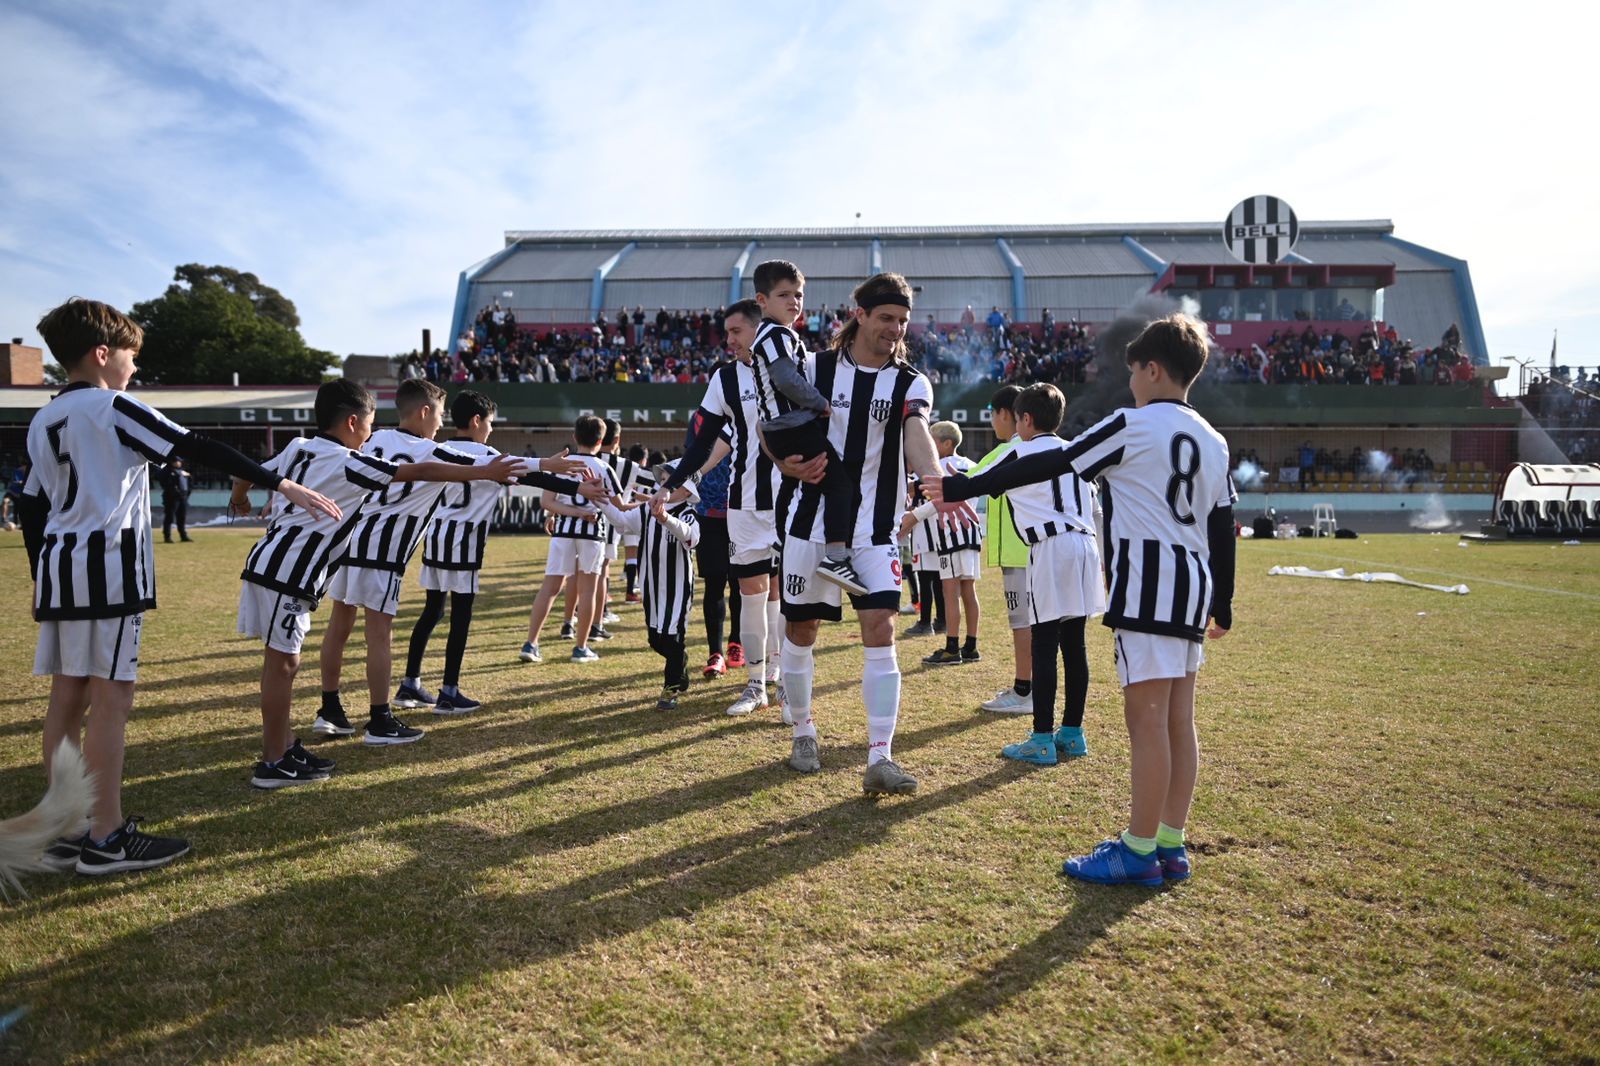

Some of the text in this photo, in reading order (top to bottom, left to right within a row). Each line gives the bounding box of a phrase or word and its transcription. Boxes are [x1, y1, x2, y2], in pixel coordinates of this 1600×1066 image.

[1235, 225, 1287, 238] BELL
[241, 409, 310, 422] CLU
[45, 416, 79, 513] 5
[1165, 431, 1201, 526] 8
[281, 613, 296, 640] 4
